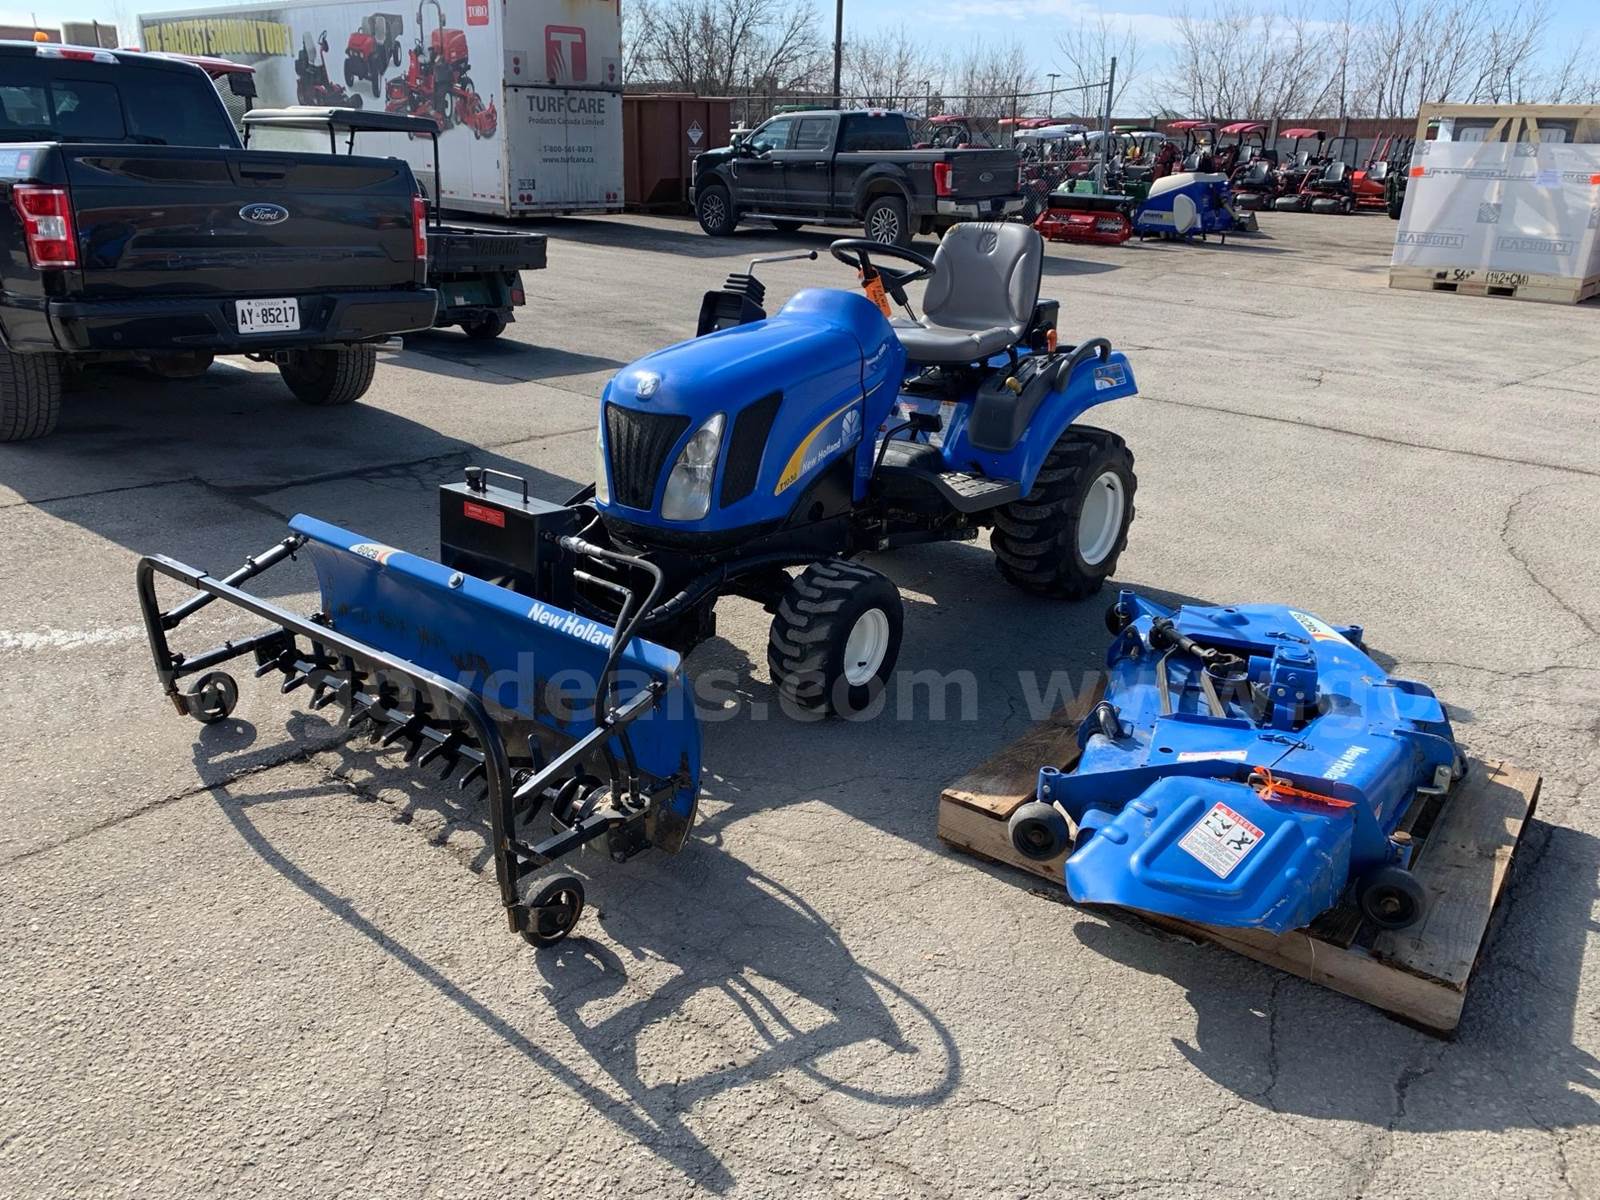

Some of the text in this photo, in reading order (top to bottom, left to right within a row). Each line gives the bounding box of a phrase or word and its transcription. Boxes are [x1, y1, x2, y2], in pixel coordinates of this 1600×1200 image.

[467, 5, 488, 17] TORO
[162, 20, 207, 55] GREATEST
[207, 18, 242, 55] SHOW
[242, 20, 257, 54] ON
[528, 116, 605, 126] Products Canada Limited
[542, 156, 594, 164] www.turfcare.ca
[251, 207, 279, 220] Ford
[241, 306, 296, 326] AY 85217
[802, 438, 842, 473] New Holland
[527, 602, 614, 649] New Hollan
